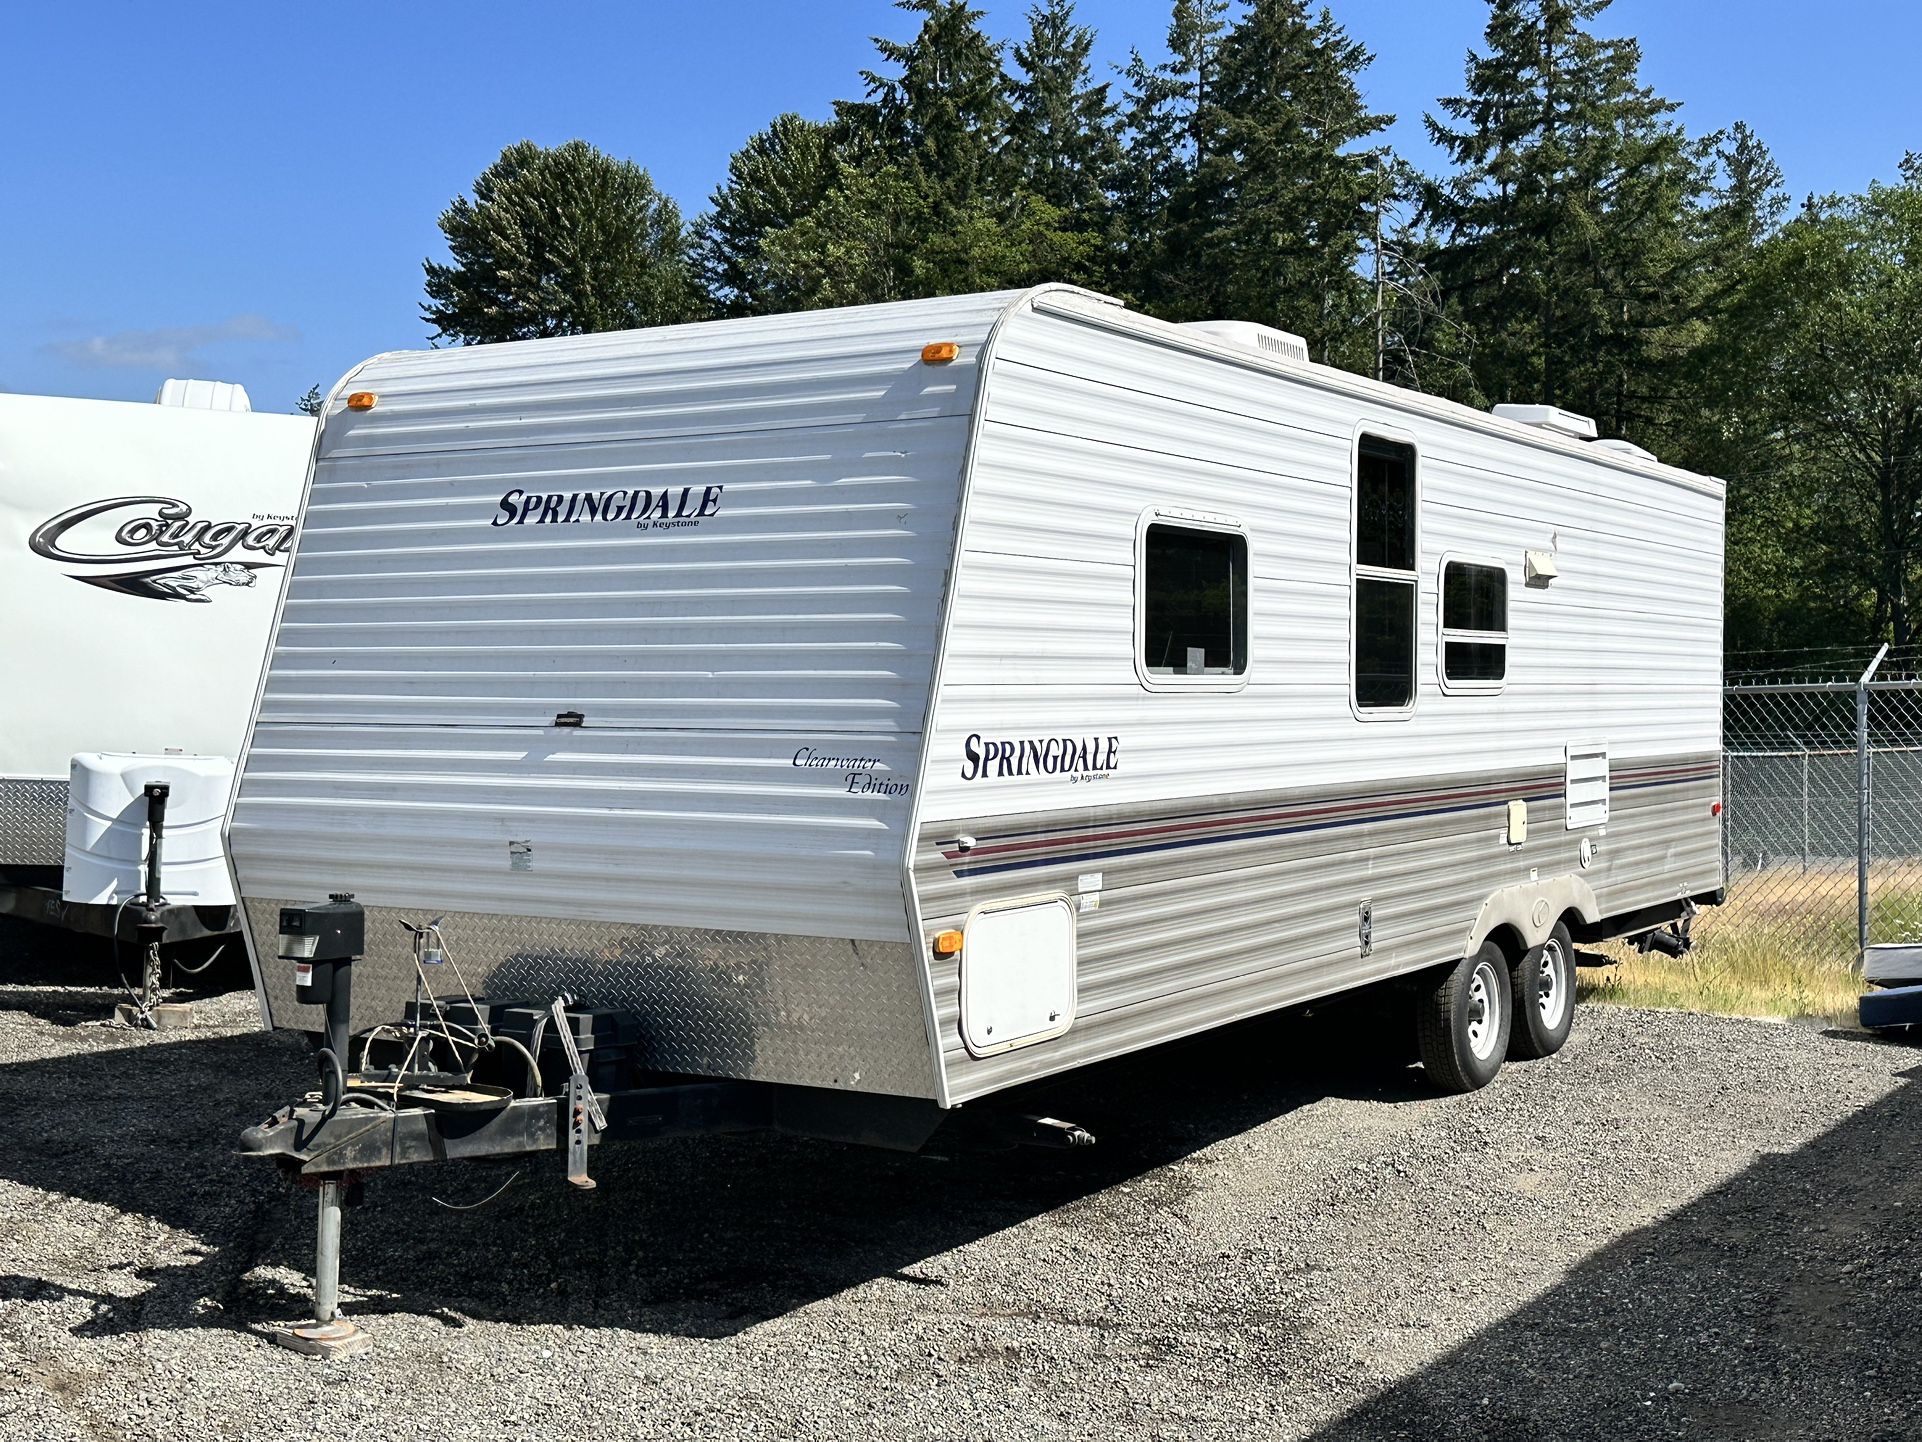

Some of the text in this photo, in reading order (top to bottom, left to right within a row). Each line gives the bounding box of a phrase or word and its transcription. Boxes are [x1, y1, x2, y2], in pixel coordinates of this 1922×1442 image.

[252, 513, 298, 522] by Keyst
[491, 485, 724, 527] SPRINGDALE
[28, 495, 294, 564] Couga
[636, 520, 700, 531] by Keystone
[792, 747, 881, 770] Clearwater
[961, 733, 1119, 781] SPRINGDALE
[845, 772, 910, 796] Edition
[1070, 774, 1079, 784] by
